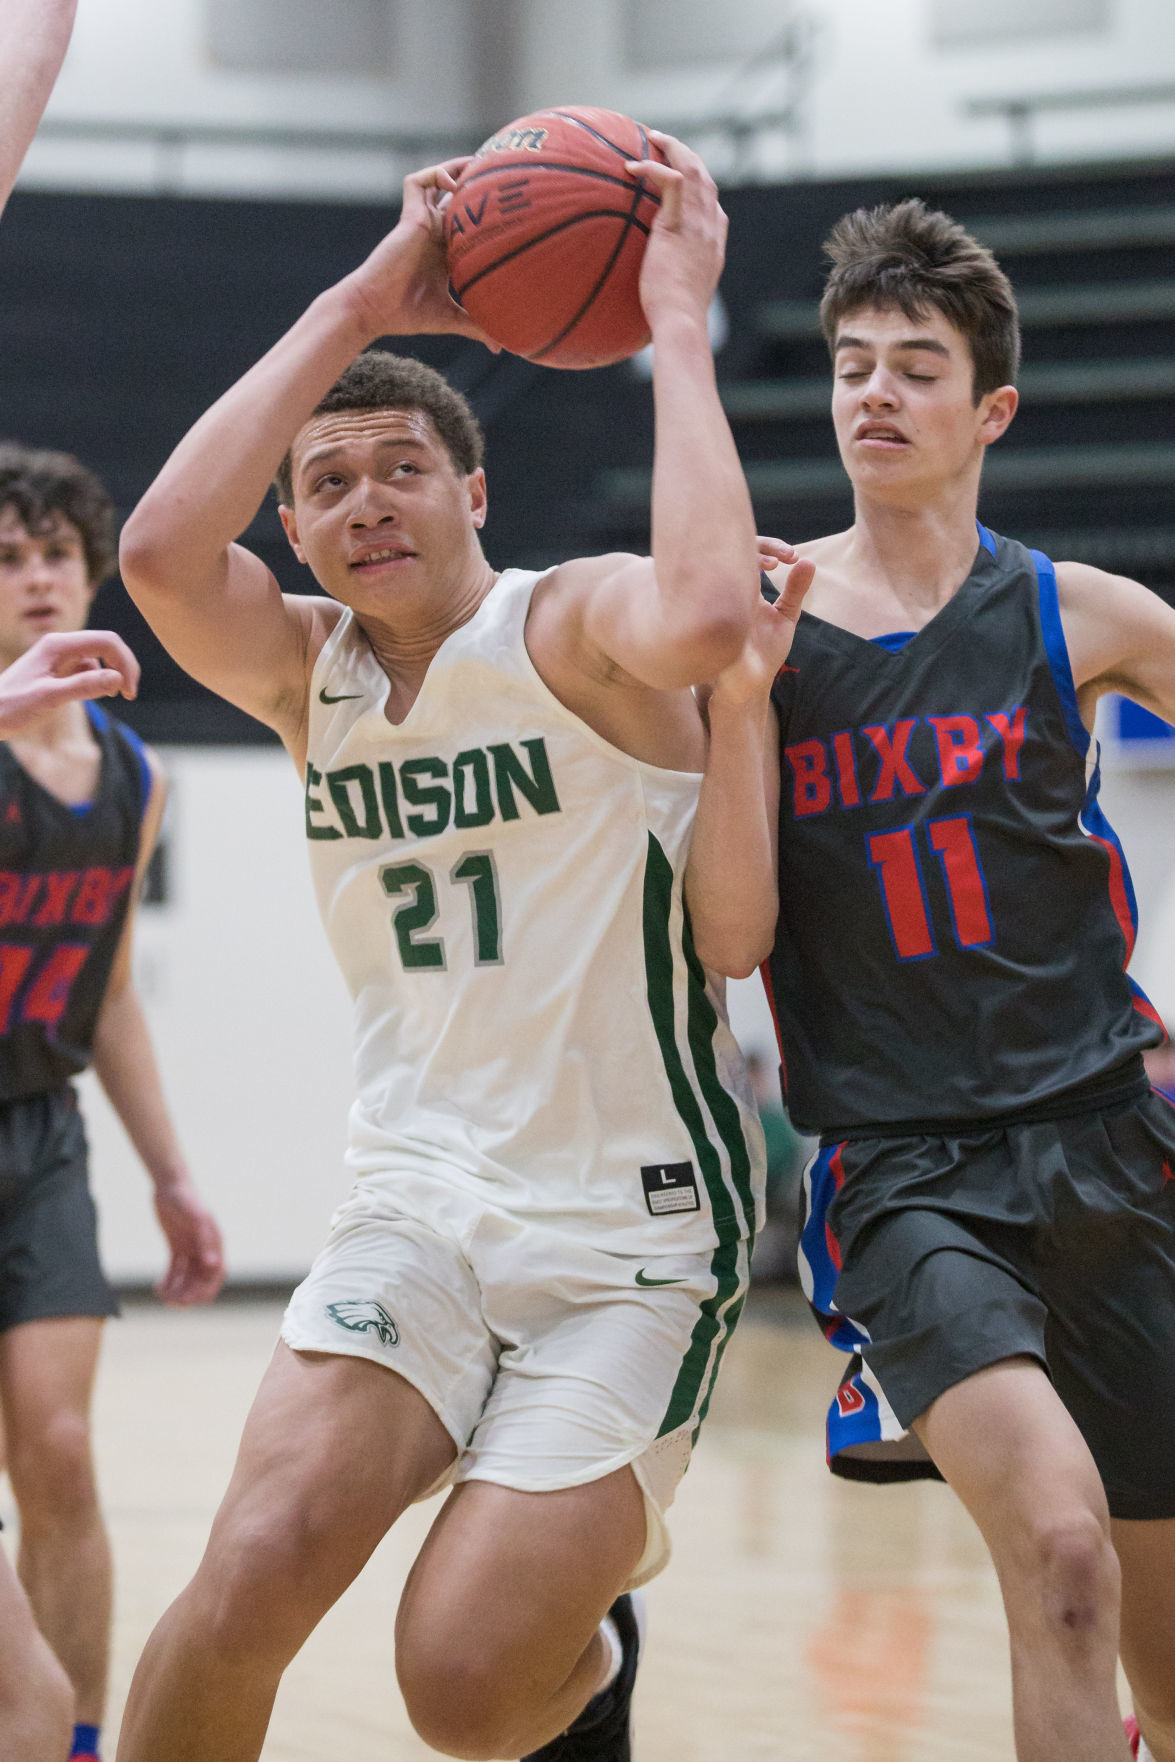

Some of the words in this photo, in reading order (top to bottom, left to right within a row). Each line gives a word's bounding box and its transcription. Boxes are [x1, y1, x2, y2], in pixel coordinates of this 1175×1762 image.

[305, 736, 562, 841] EDISON
[784, 704, 1030, 820] BIXBY
[377, 848, 505, 973] 21
[864, 811, 996, 963] 11
[660, 1168, 676, 1184] L
